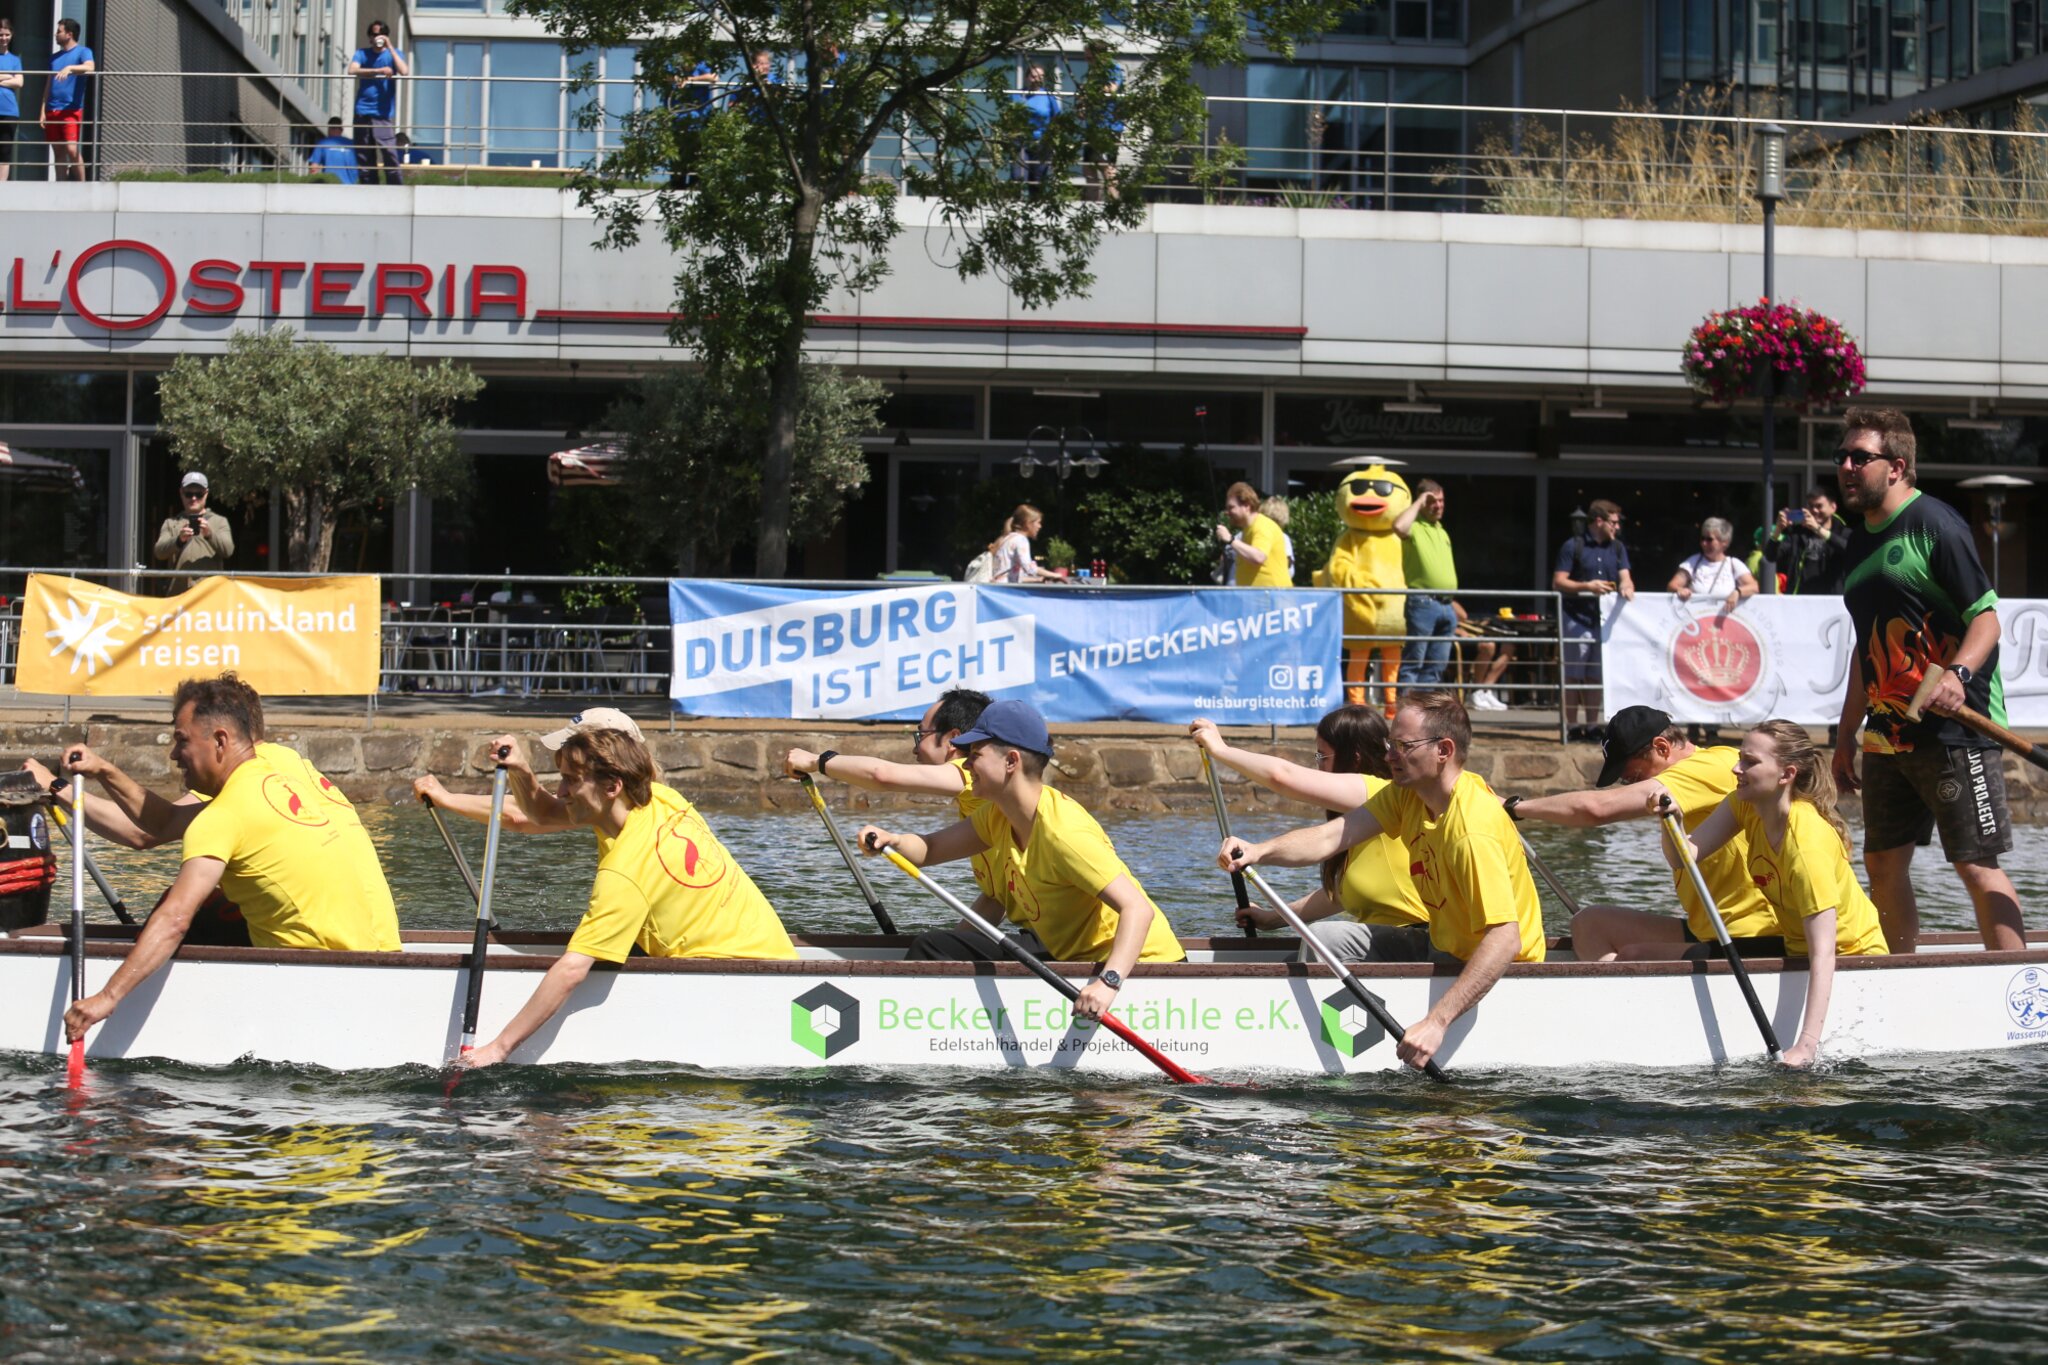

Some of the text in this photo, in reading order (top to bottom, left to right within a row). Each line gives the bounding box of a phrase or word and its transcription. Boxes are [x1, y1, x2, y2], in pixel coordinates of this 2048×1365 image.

[143, 604, 356, 635] schauinsland
[686, 590, 956, 680] DUISBURG
[139, 638, 240, 666] reisen
[1050, 602, 1317, 678] ENTDECKENSWERT
[812, 635, 1014, 708] IST ECHT
[1194, 695, 1327, 710] duisburgistecht.de
[1973, 775, 1996, 836] PROJECTS
[879, 997, 1299, 1030] Becker Edetähle e.K.
[930, 1038, 1208, 1054] Edelstahlhandel & Projektbleitung
